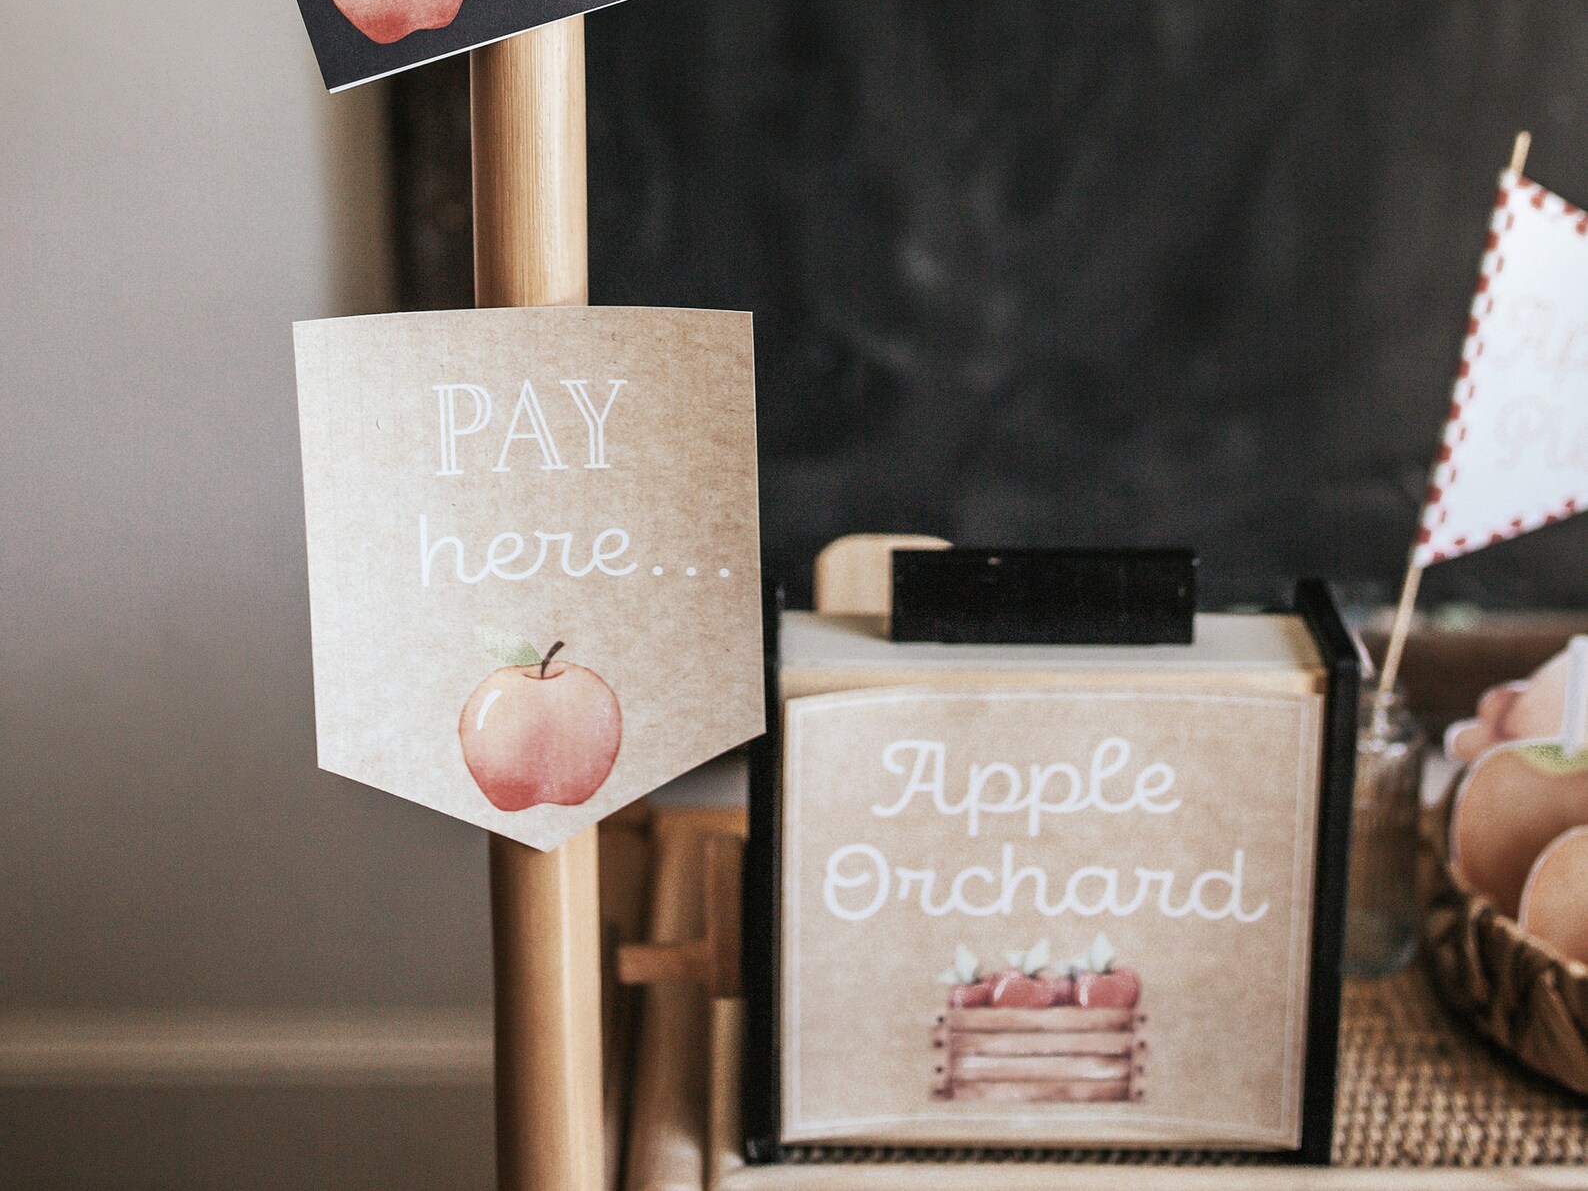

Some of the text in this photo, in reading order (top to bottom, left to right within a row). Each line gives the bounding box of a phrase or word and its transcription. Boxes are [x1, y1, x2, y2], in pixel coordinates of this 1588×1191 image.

[432, 378, 628, 477] PAY
[418, 513, 731, 588] here...
[870, 736, 1182, 837] Apple
[822, 843, 1270, 923] Orchard
